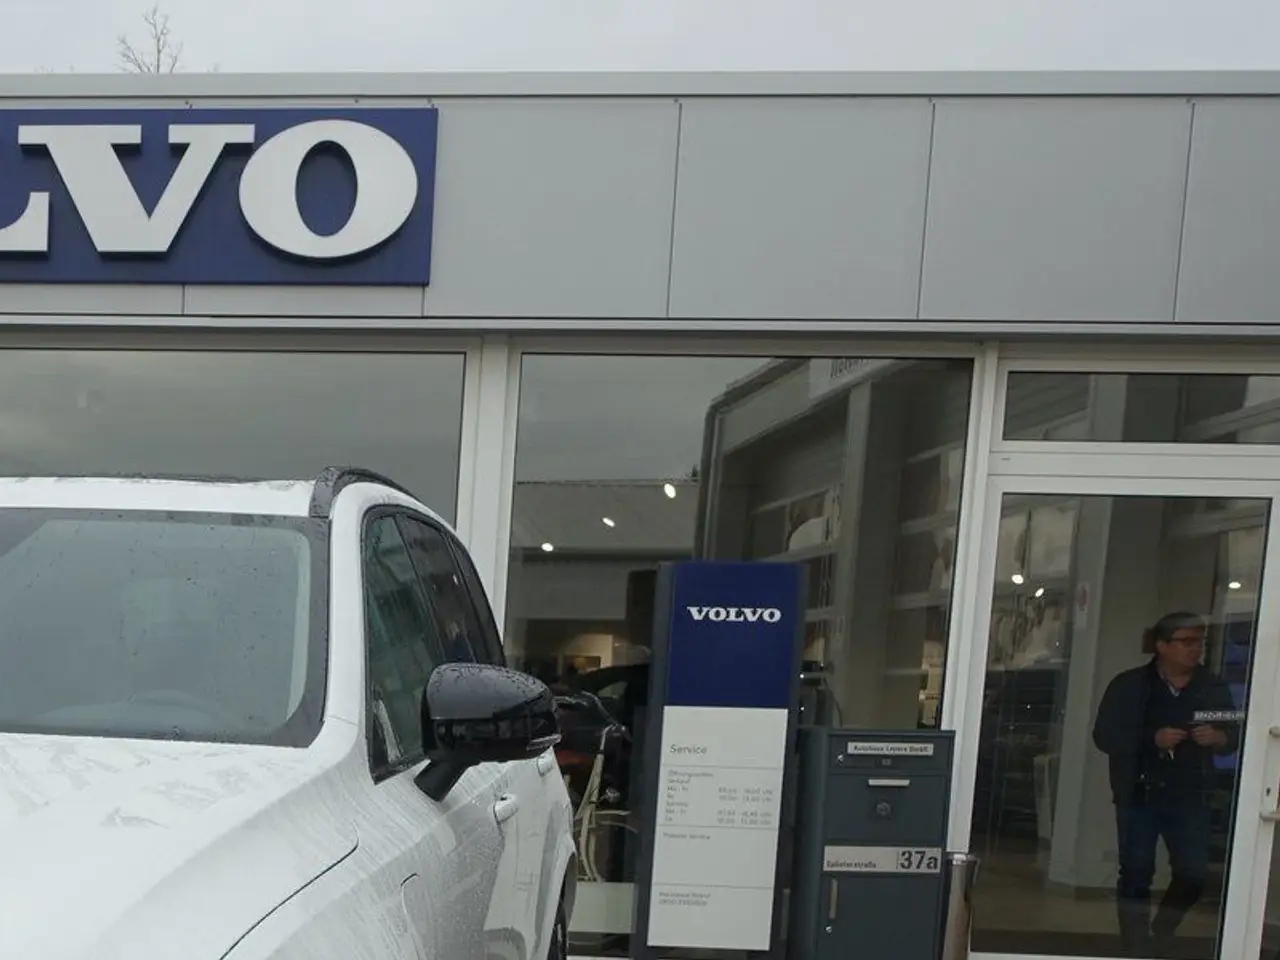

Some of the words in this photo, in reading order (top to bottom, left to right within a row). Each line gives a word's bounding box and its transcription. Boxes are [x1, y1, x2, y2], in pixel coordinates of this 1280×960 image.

[686, 606, 781, 622] VOLVO
[669, 744, 708, 755] Service
[900, 850, 939, 870] 37a
